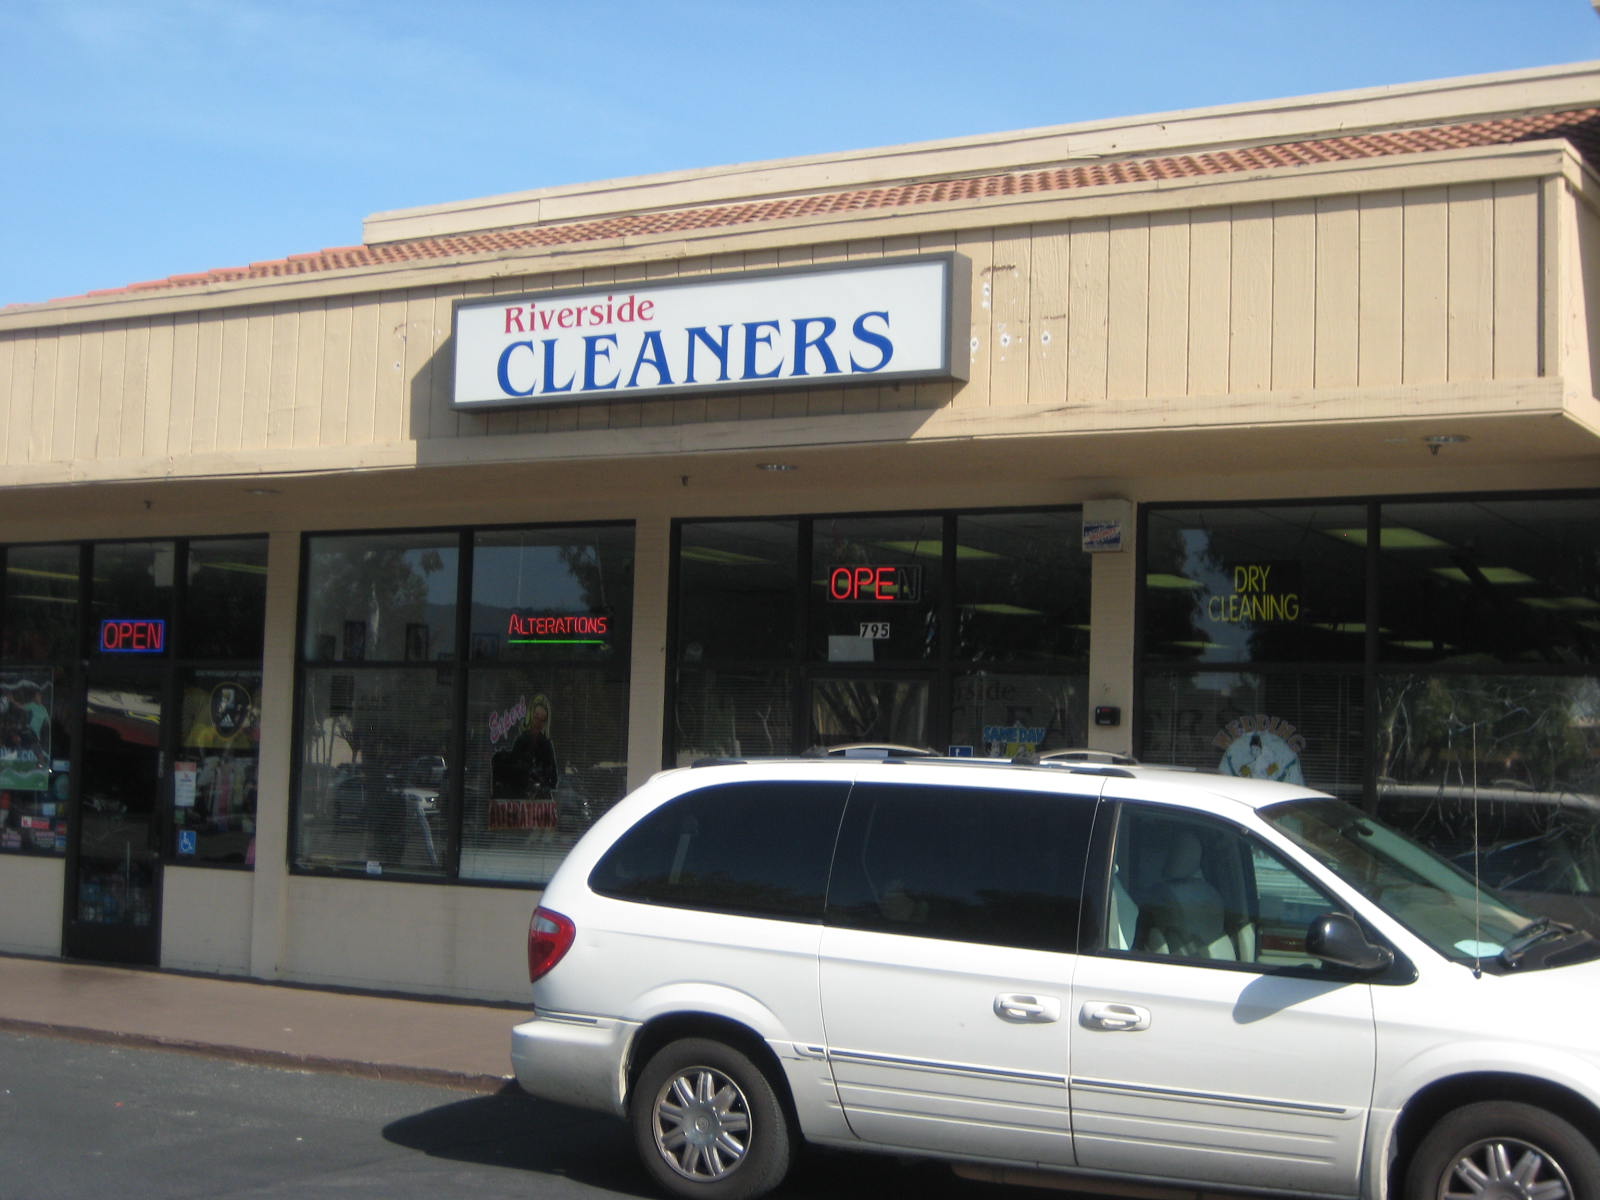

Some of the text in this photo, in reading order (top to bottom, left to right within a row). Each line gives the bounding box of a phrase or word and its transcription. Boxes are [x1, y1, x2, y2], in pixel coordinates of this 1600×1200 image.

[503, 294, 655, 334] Riverside
[496, 310, 895, 397] CLEANERS
[831, 566, 918, 601] OPEN
[1233, 564, 1272, 593] DRY
[1208, 593, 1300, 622] CLEANING
[103, 622, 163, 650] OPEN
[507, 613, 609, 635] ALTERATIONS
[861, 623, 889, 638] 795
